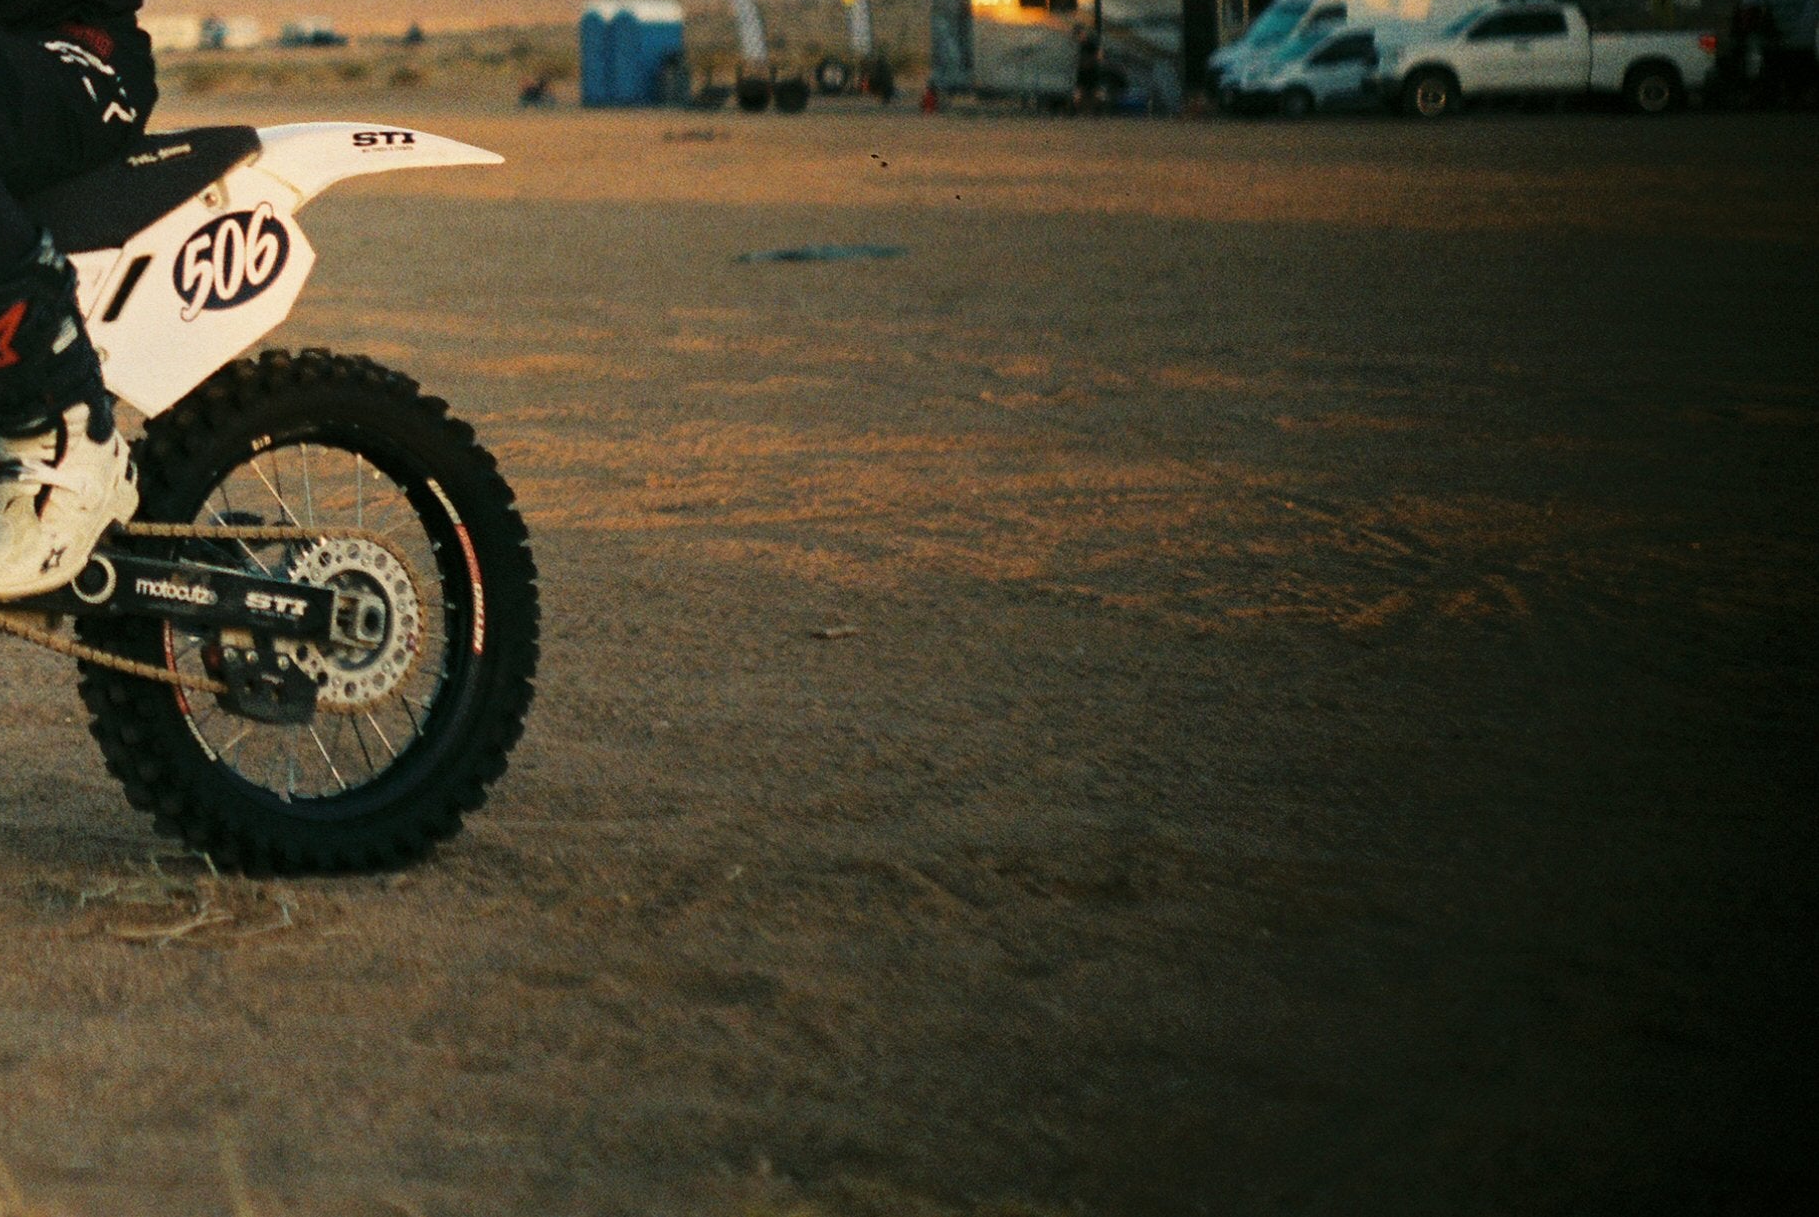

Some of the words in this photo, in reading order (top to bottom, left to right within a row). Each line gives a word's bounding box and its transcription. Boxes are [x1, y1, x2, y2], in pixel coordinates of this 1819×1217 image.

[352, 131, 416, 147] STI
[181, 201, 280, 322] 506
[245, 592, 308, 616] STI
